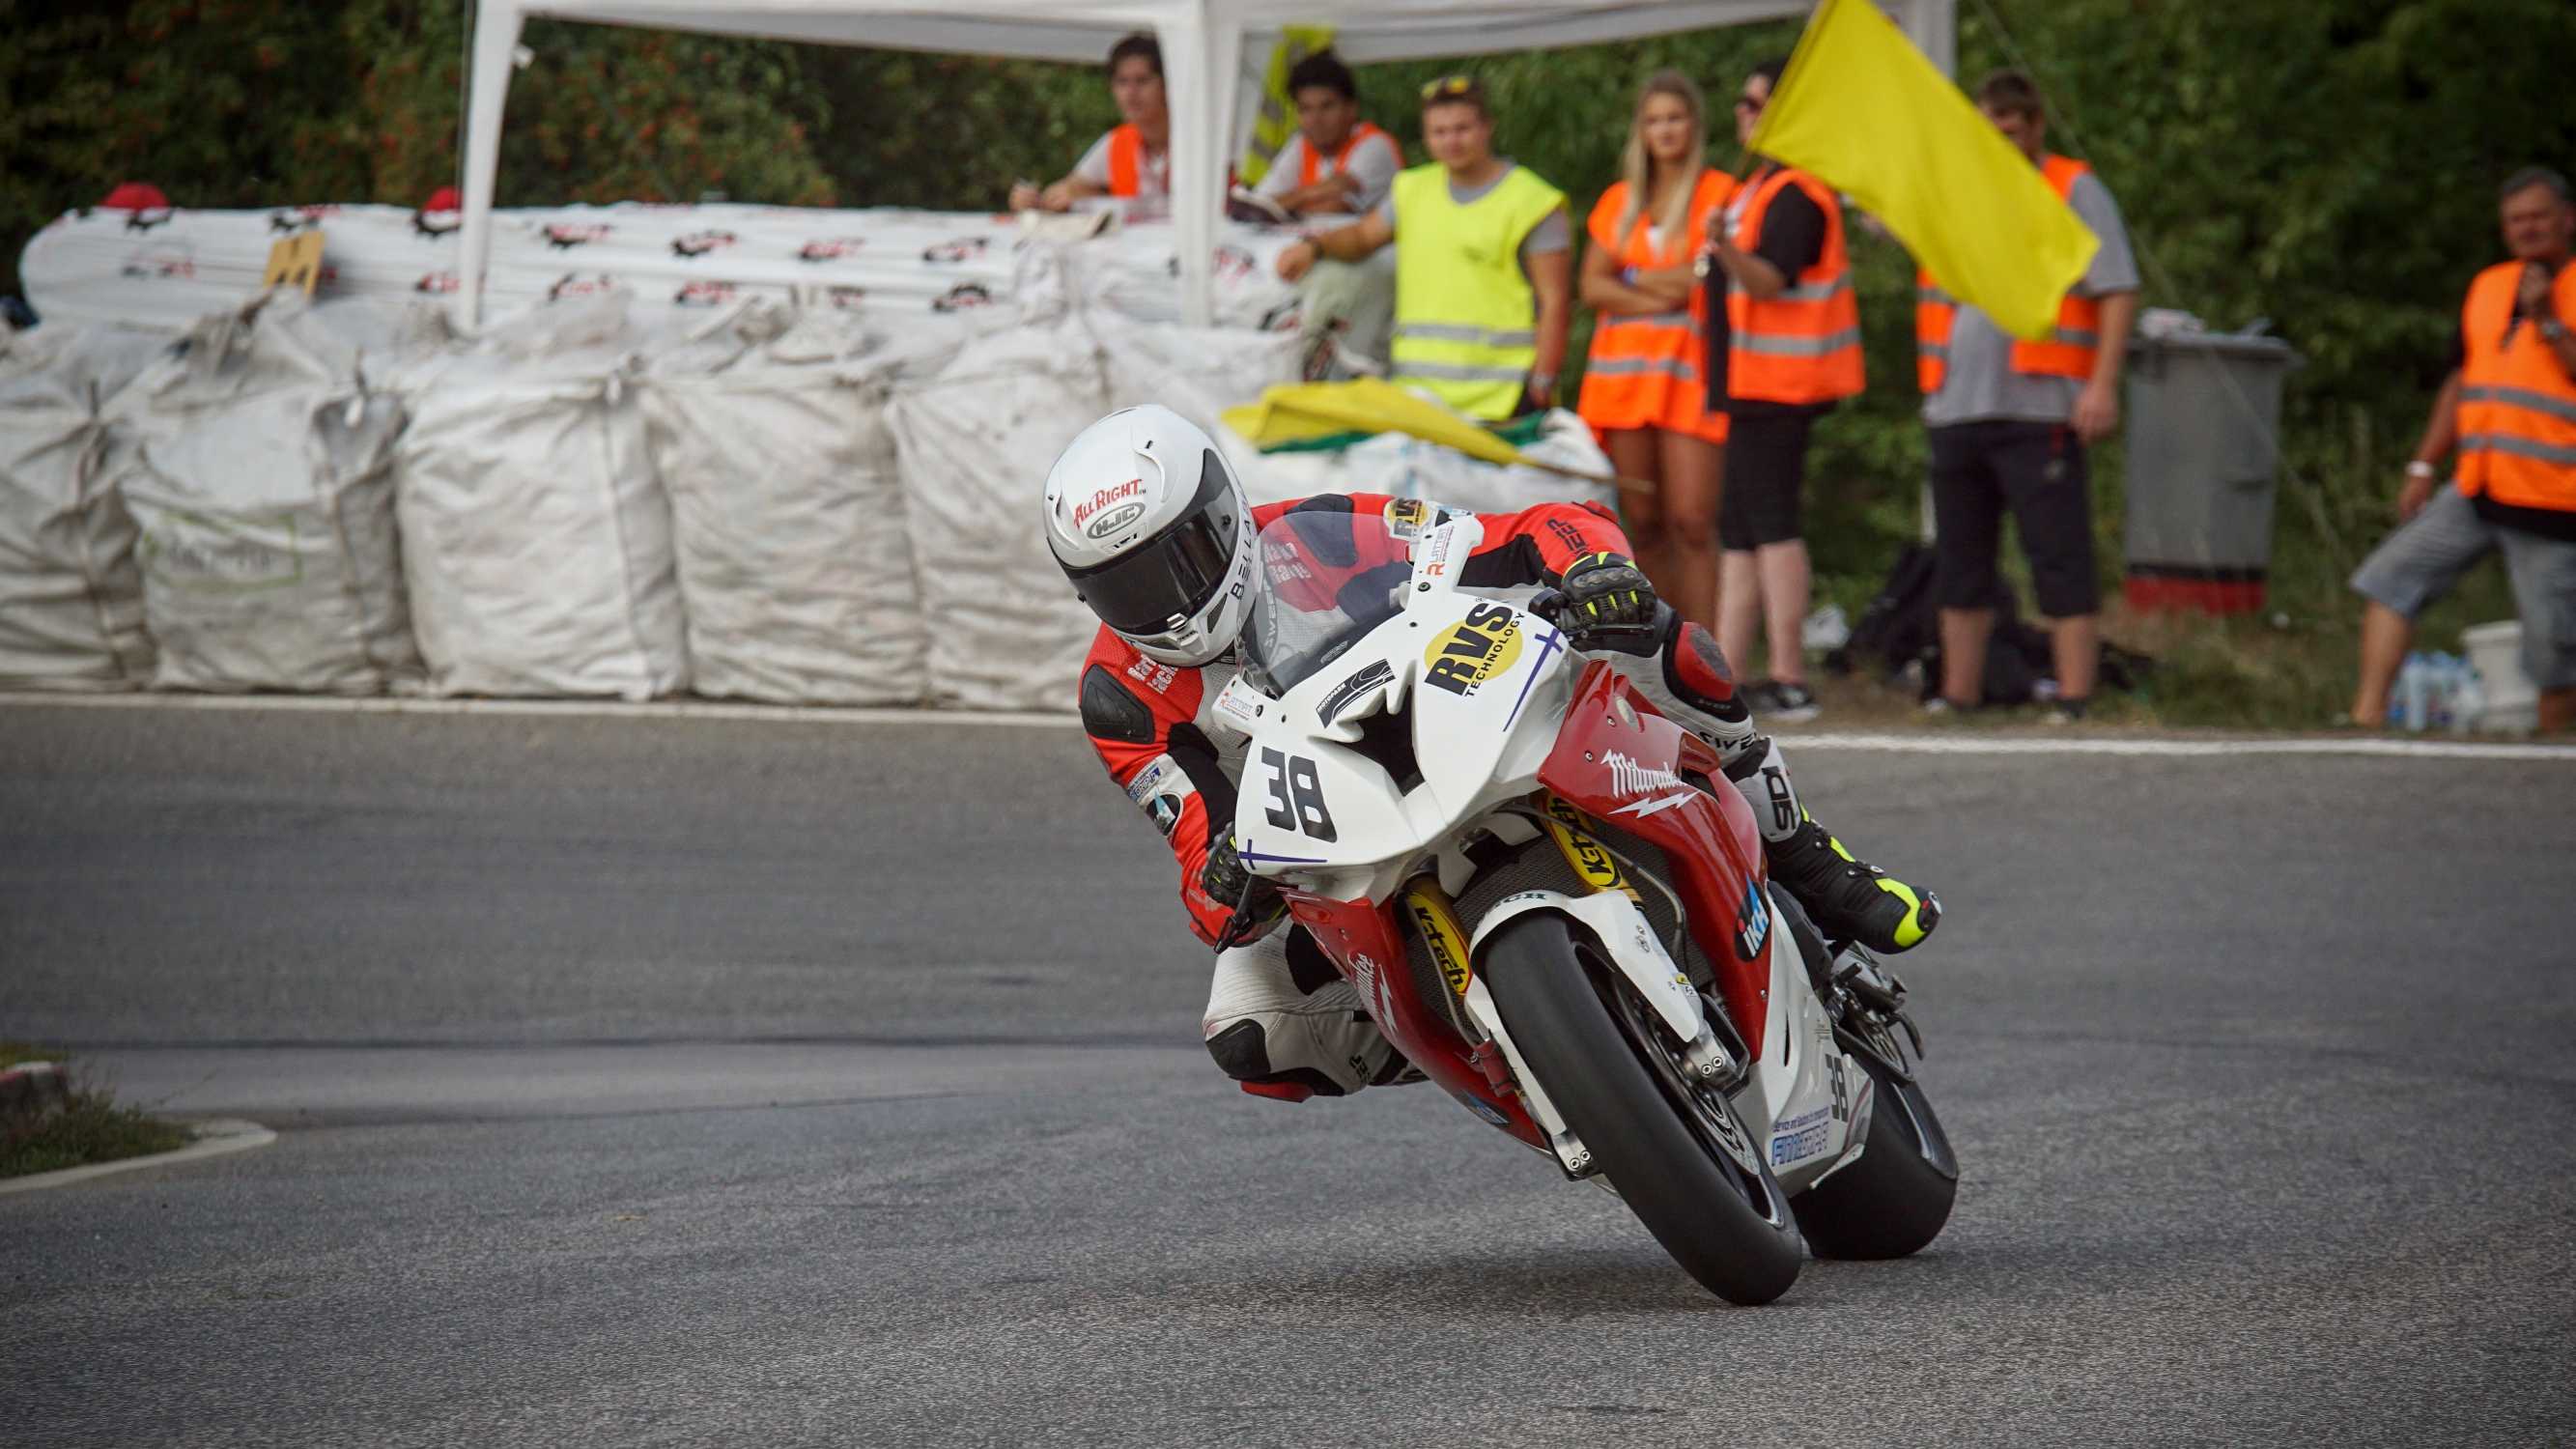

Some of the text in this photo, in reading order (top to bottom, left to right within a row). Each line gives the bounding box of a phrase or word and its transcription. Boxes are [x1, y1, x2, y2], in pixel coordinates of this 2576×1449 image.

[1424, 601, 1514, 696] RVS
[1463, 611, 1526, 698] TECHNOLOGY
[1260, 745, 1338, 844] 38
[1825, 1053, 1850, 1122] 38
